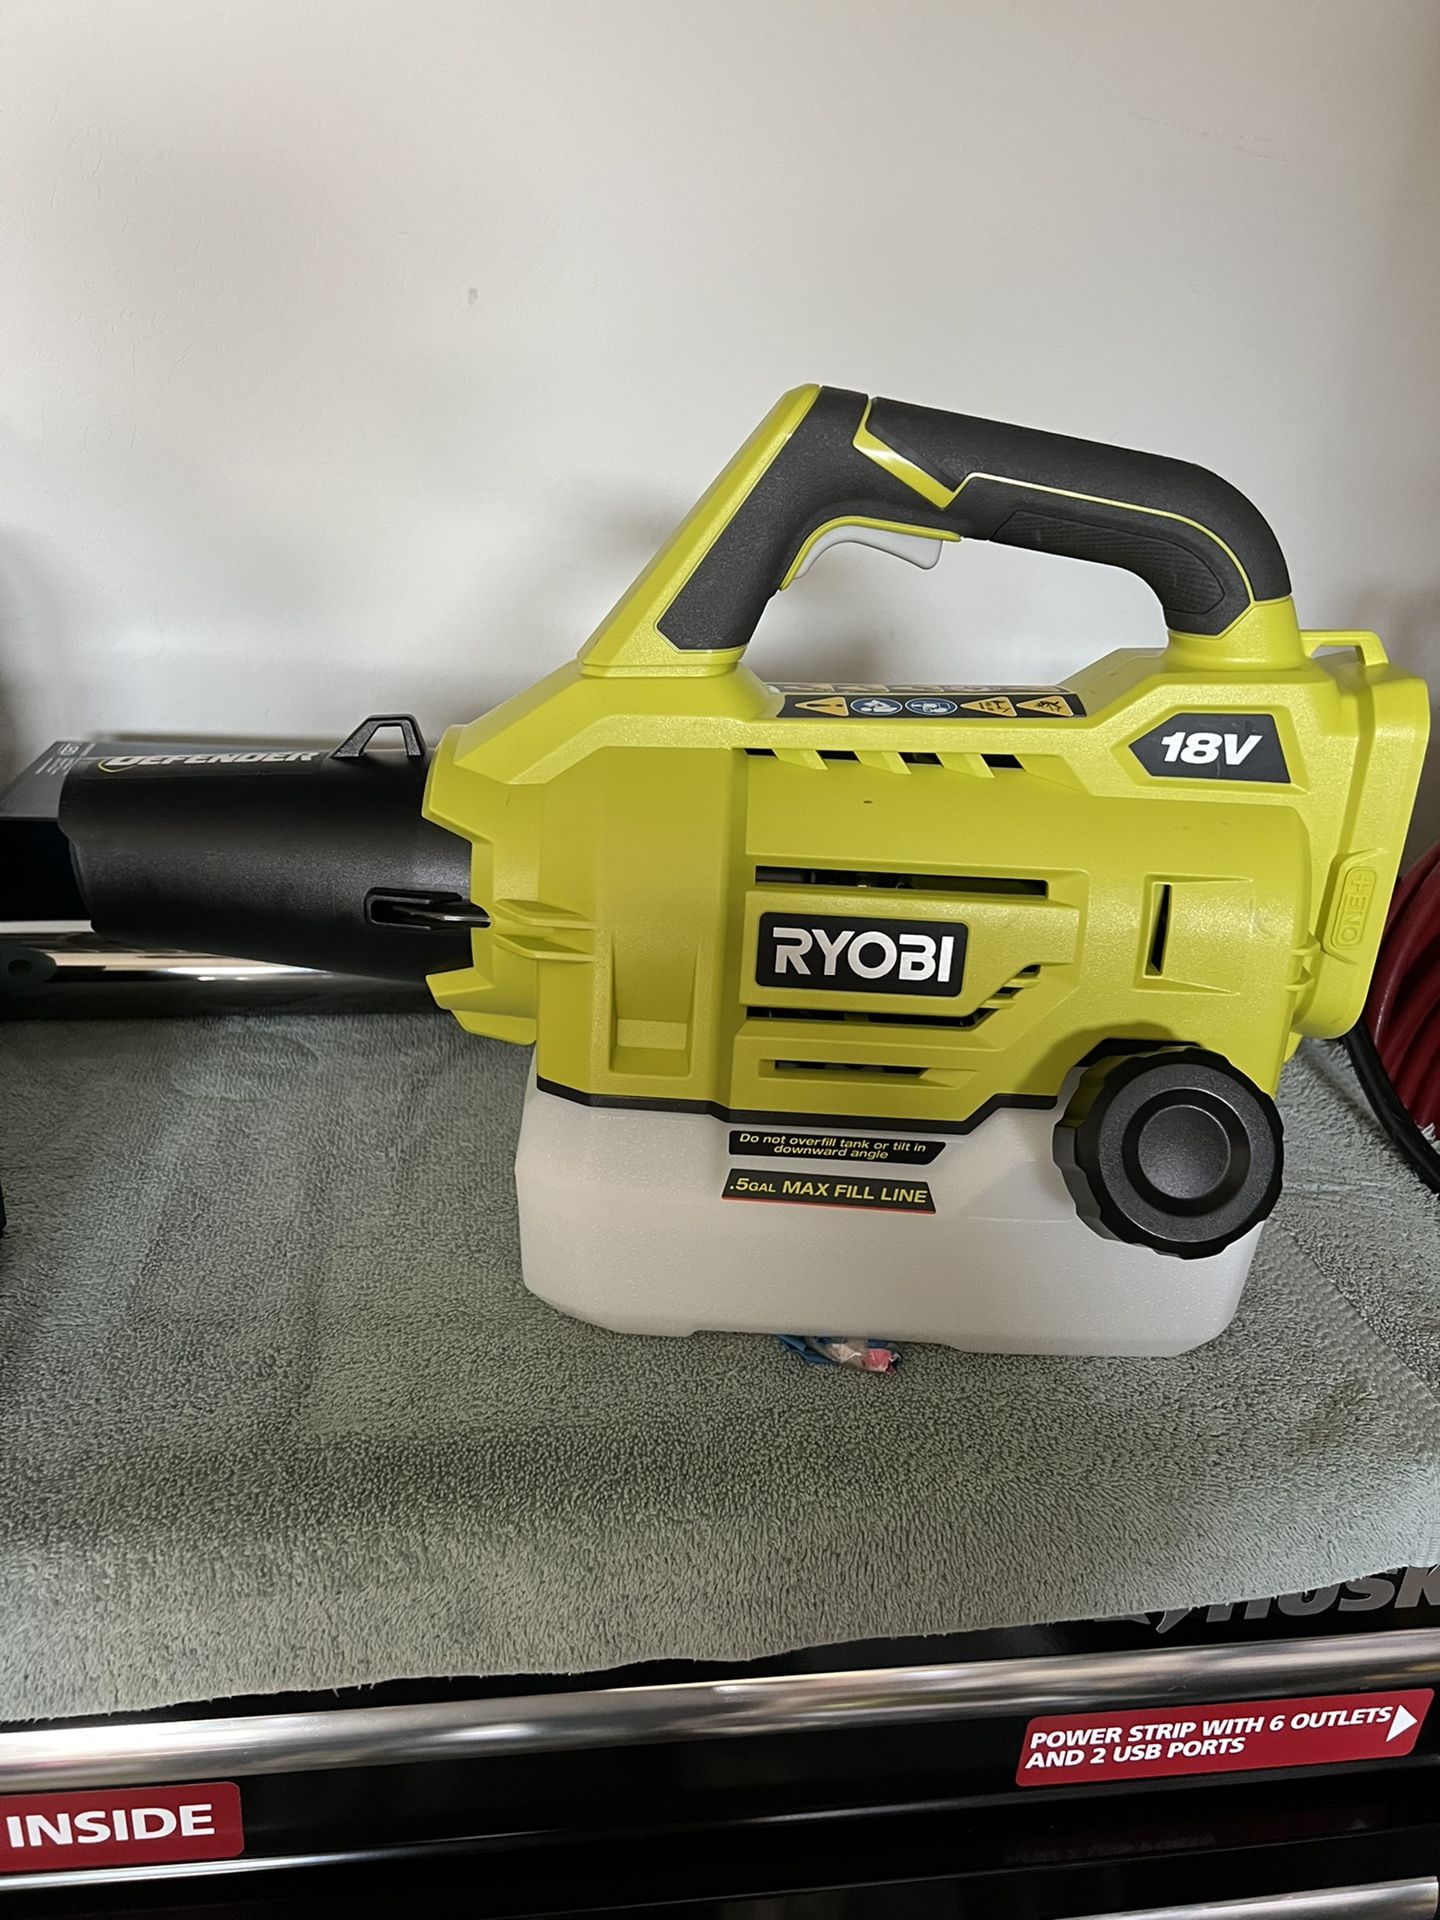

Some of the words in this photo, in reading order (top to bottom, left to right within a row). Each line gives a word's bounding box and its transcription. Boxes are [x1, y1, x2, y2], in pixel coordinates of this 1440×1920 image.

[104, 752, 320, 767] DEFENDER
[1161, 731, 1263, 765] 18V
[772, 927, 955, 983] RYOBI
[739, 1133, 760, 1143] Do
[763, 1135, 786, 1145] not
[789, 1136, 837, 1147] overfill
[840, 1138, 870, 1149] tank
[874, 1142, 890, 1150] or
[892, 1141, 911, 1152] tilt
[914, 1143, 926, 1152] in
[773, 1145, 847, 1157] downward
[850, 1149, 889, 1160] angle
[782, 1180, 829, 1197] MAX
[834, 1184, 875, 1200] FILL
[880, 1187, 928, 1203] LINE
[1030, 1725, 1121, 1749] POWER
[1127, 1721, 1196, 1743] STRIP
[1201, 1716, 1263, 1737] WITH
[1269, 1715, 1286, 1732] 6
[1291, 1706, 1394, 1730] OUTLETS
[1025, 1750, 1085, 1769] AND
[1090, 1748, 1106, 1765] 2
[1112, 1743, 1162, 1762] USB
[1167, 1737, 1245, 1759] PORTS
[6, 1803, 215, 1848] INSIDE
